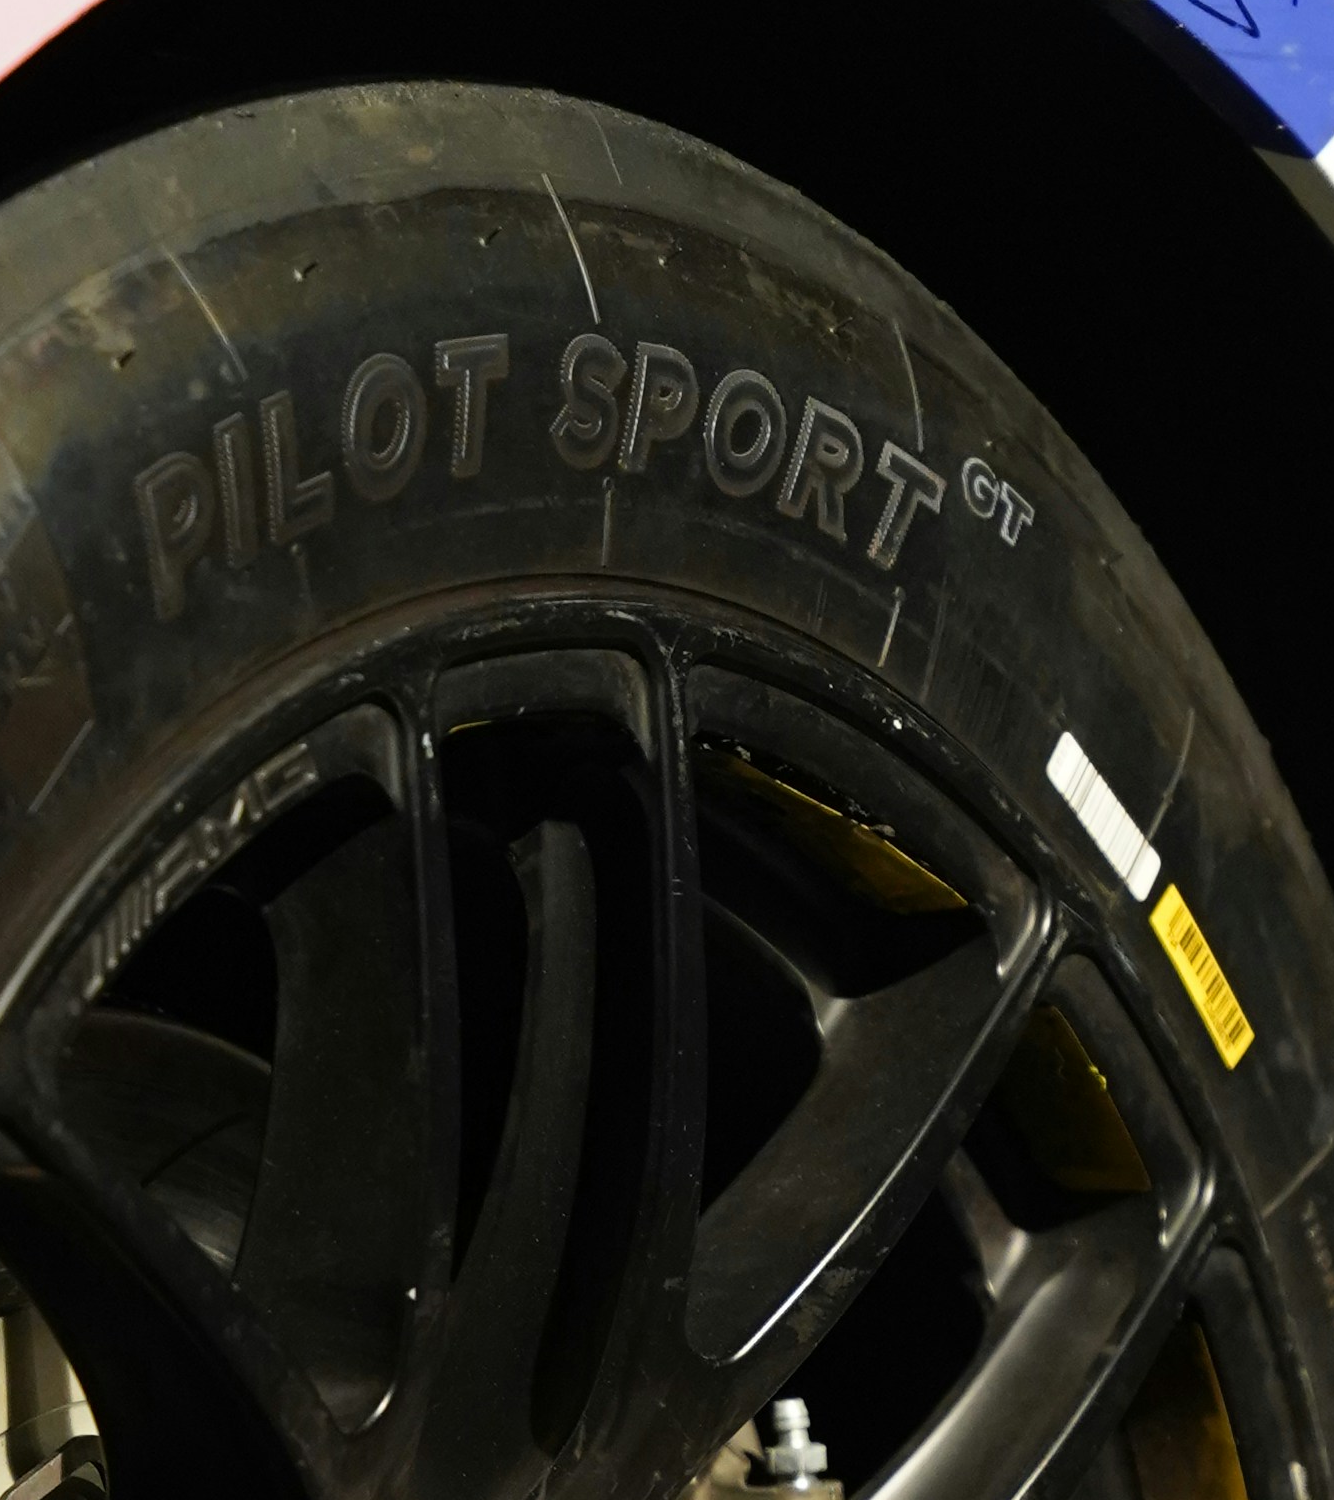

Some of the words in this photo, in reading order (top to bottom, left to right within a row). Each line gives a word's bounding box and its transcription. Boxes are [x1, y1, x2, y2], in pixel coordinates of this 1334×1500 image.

[132, 332, 510, 623] PILOT
[547, 331, 949, 572] SPORT
[958, 455, 1037, 548] GT
